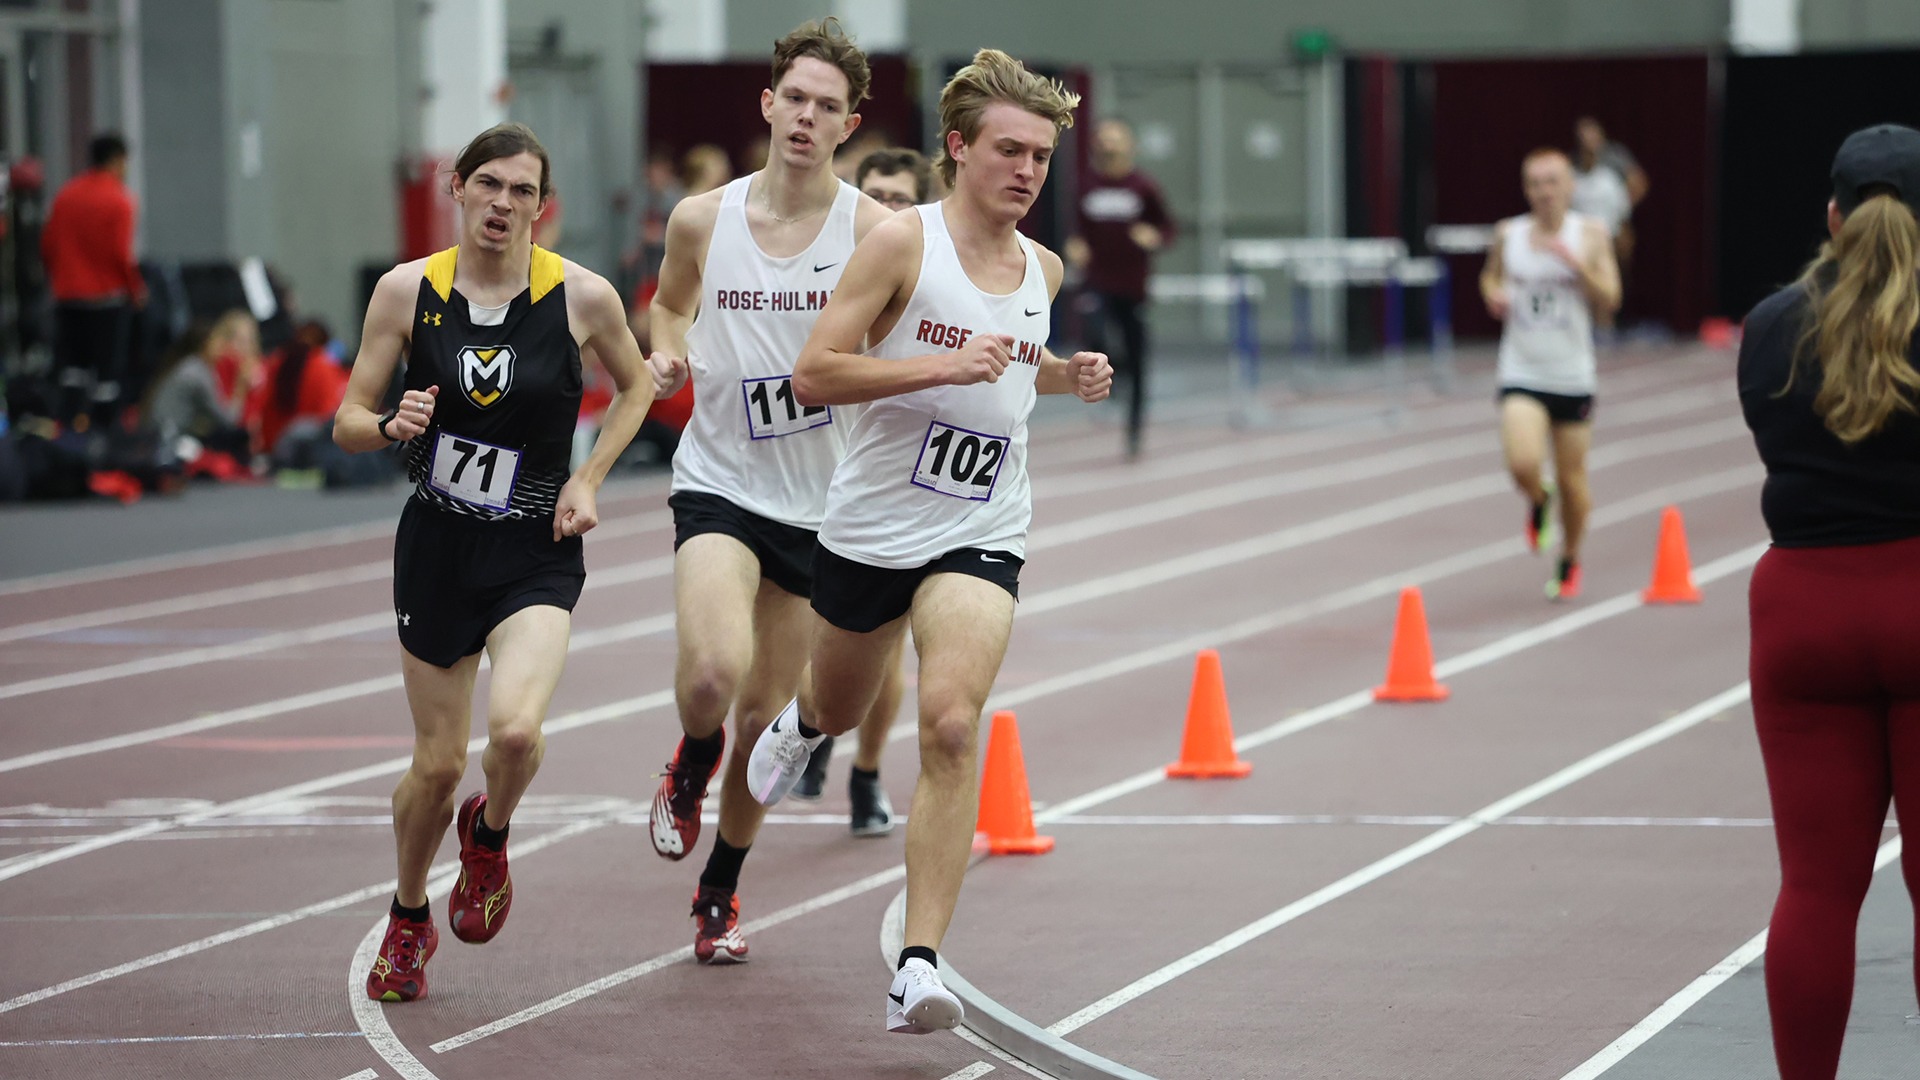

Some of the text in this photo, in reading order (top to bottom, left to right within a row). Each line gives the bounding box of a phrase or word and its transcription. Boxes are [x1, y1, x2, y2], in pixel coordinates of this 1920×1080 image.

[717, 289, 834, 311] ROSE-HULMA
[450, 439, 499, 493] 71
[929, 429, 1003, 487] 102
